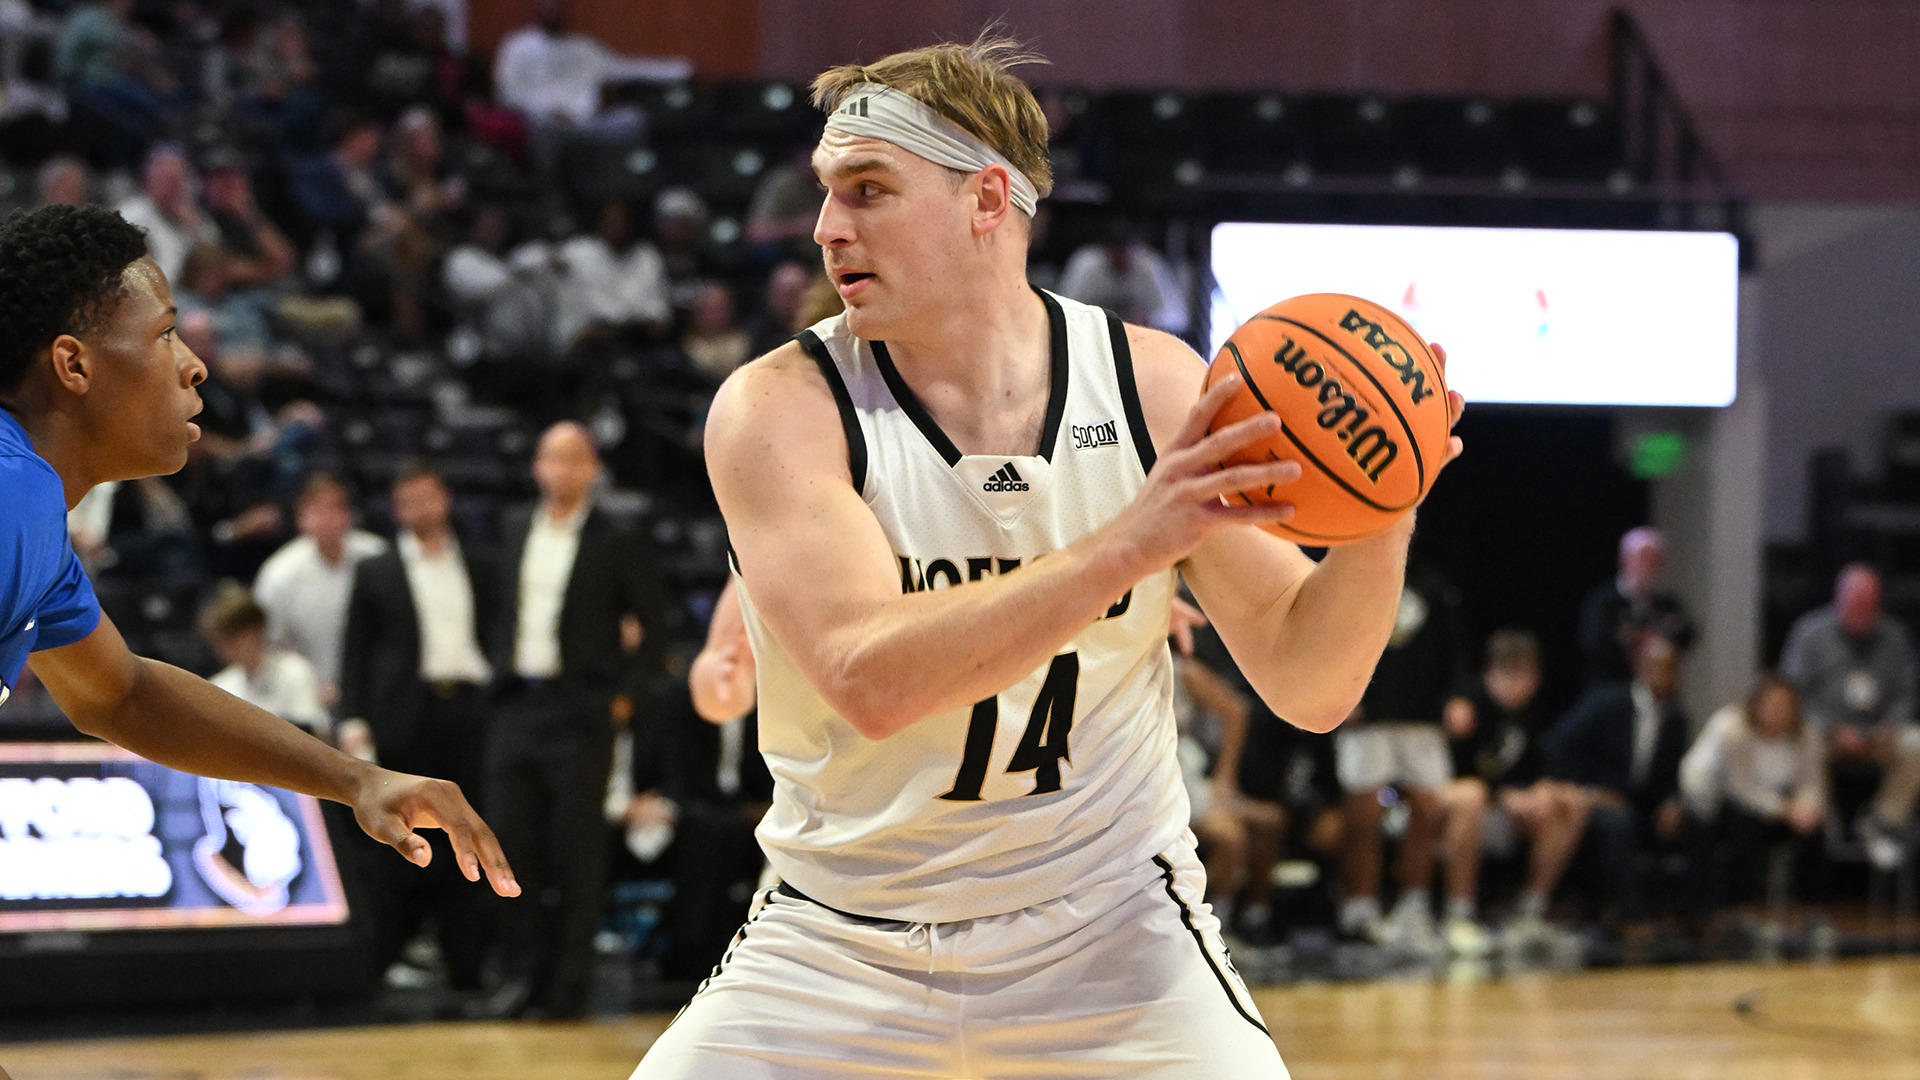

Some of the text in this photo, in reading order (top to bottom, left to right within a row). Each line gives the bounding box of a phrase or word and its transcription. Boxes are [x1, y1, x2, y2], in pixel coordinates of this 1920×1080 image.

[1274, 334, 1398, 484] Wilson
[1339, 309, 1434, 405] NCAA
[983, 480, 1030, 492] adidas
[933, 650, 1080, 801] 14
